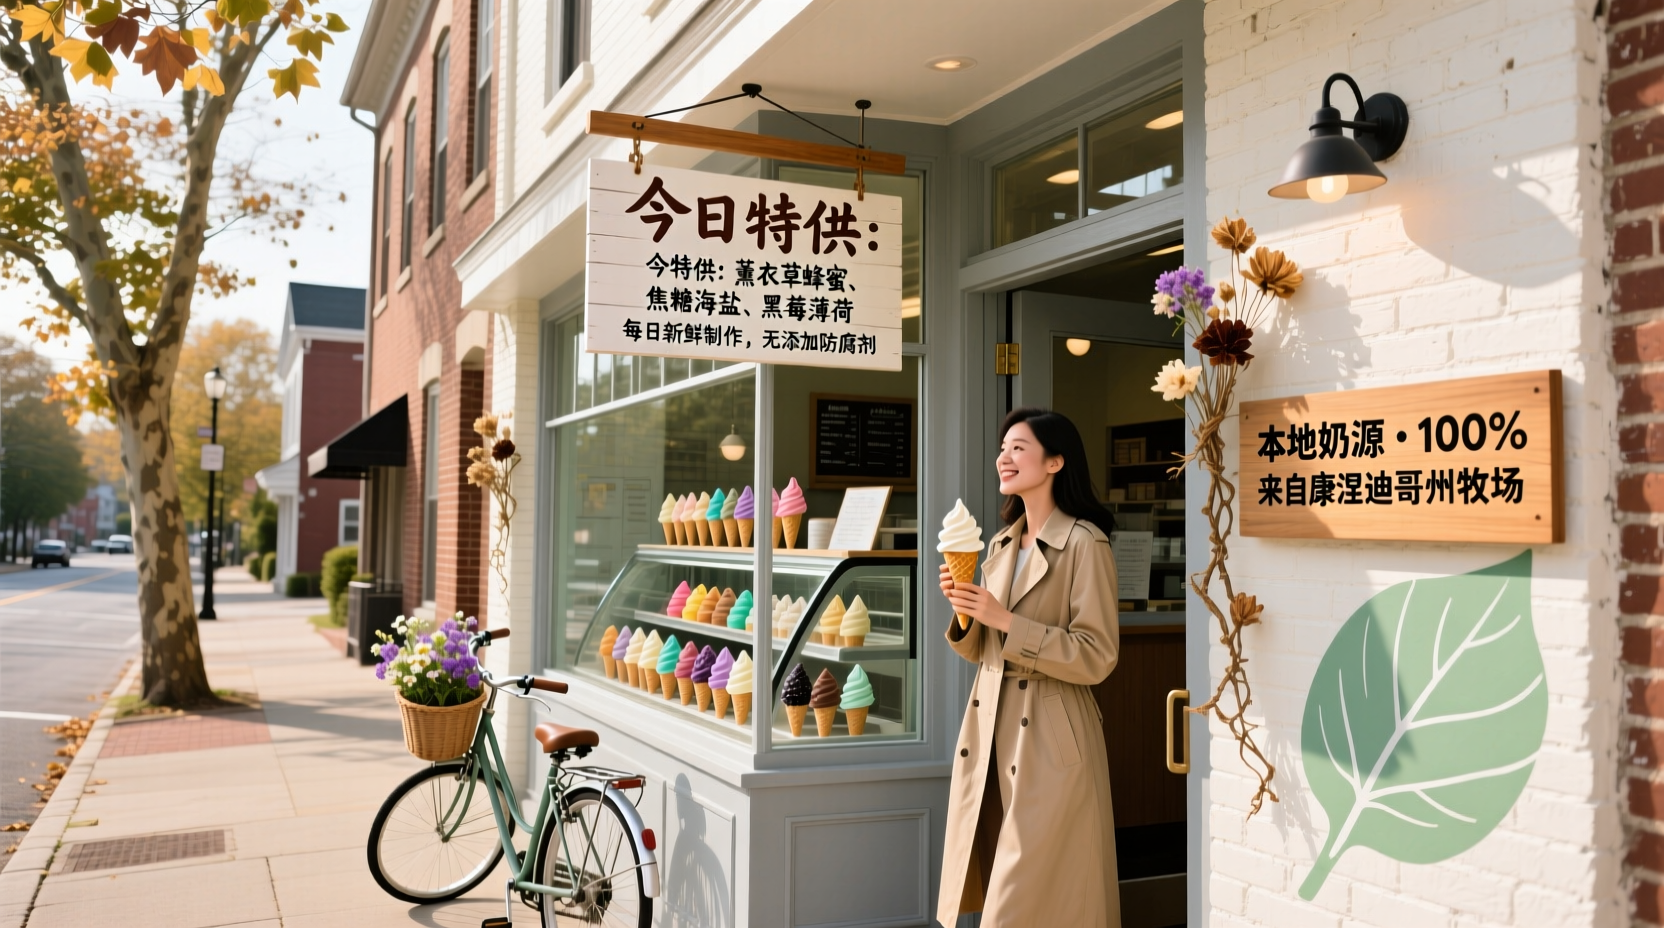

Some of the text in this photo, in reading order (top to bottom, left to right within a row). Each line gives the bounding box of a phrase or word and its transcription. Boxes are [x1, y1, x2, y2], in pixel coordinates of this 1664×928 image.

[625, 176, 879, 258] 今日特供：
[646, 285, 854, 324] 焦糖海盐、黑莓薄荷
[1257, 466, 1524, 507] 来自康涅迪哥州牧场
